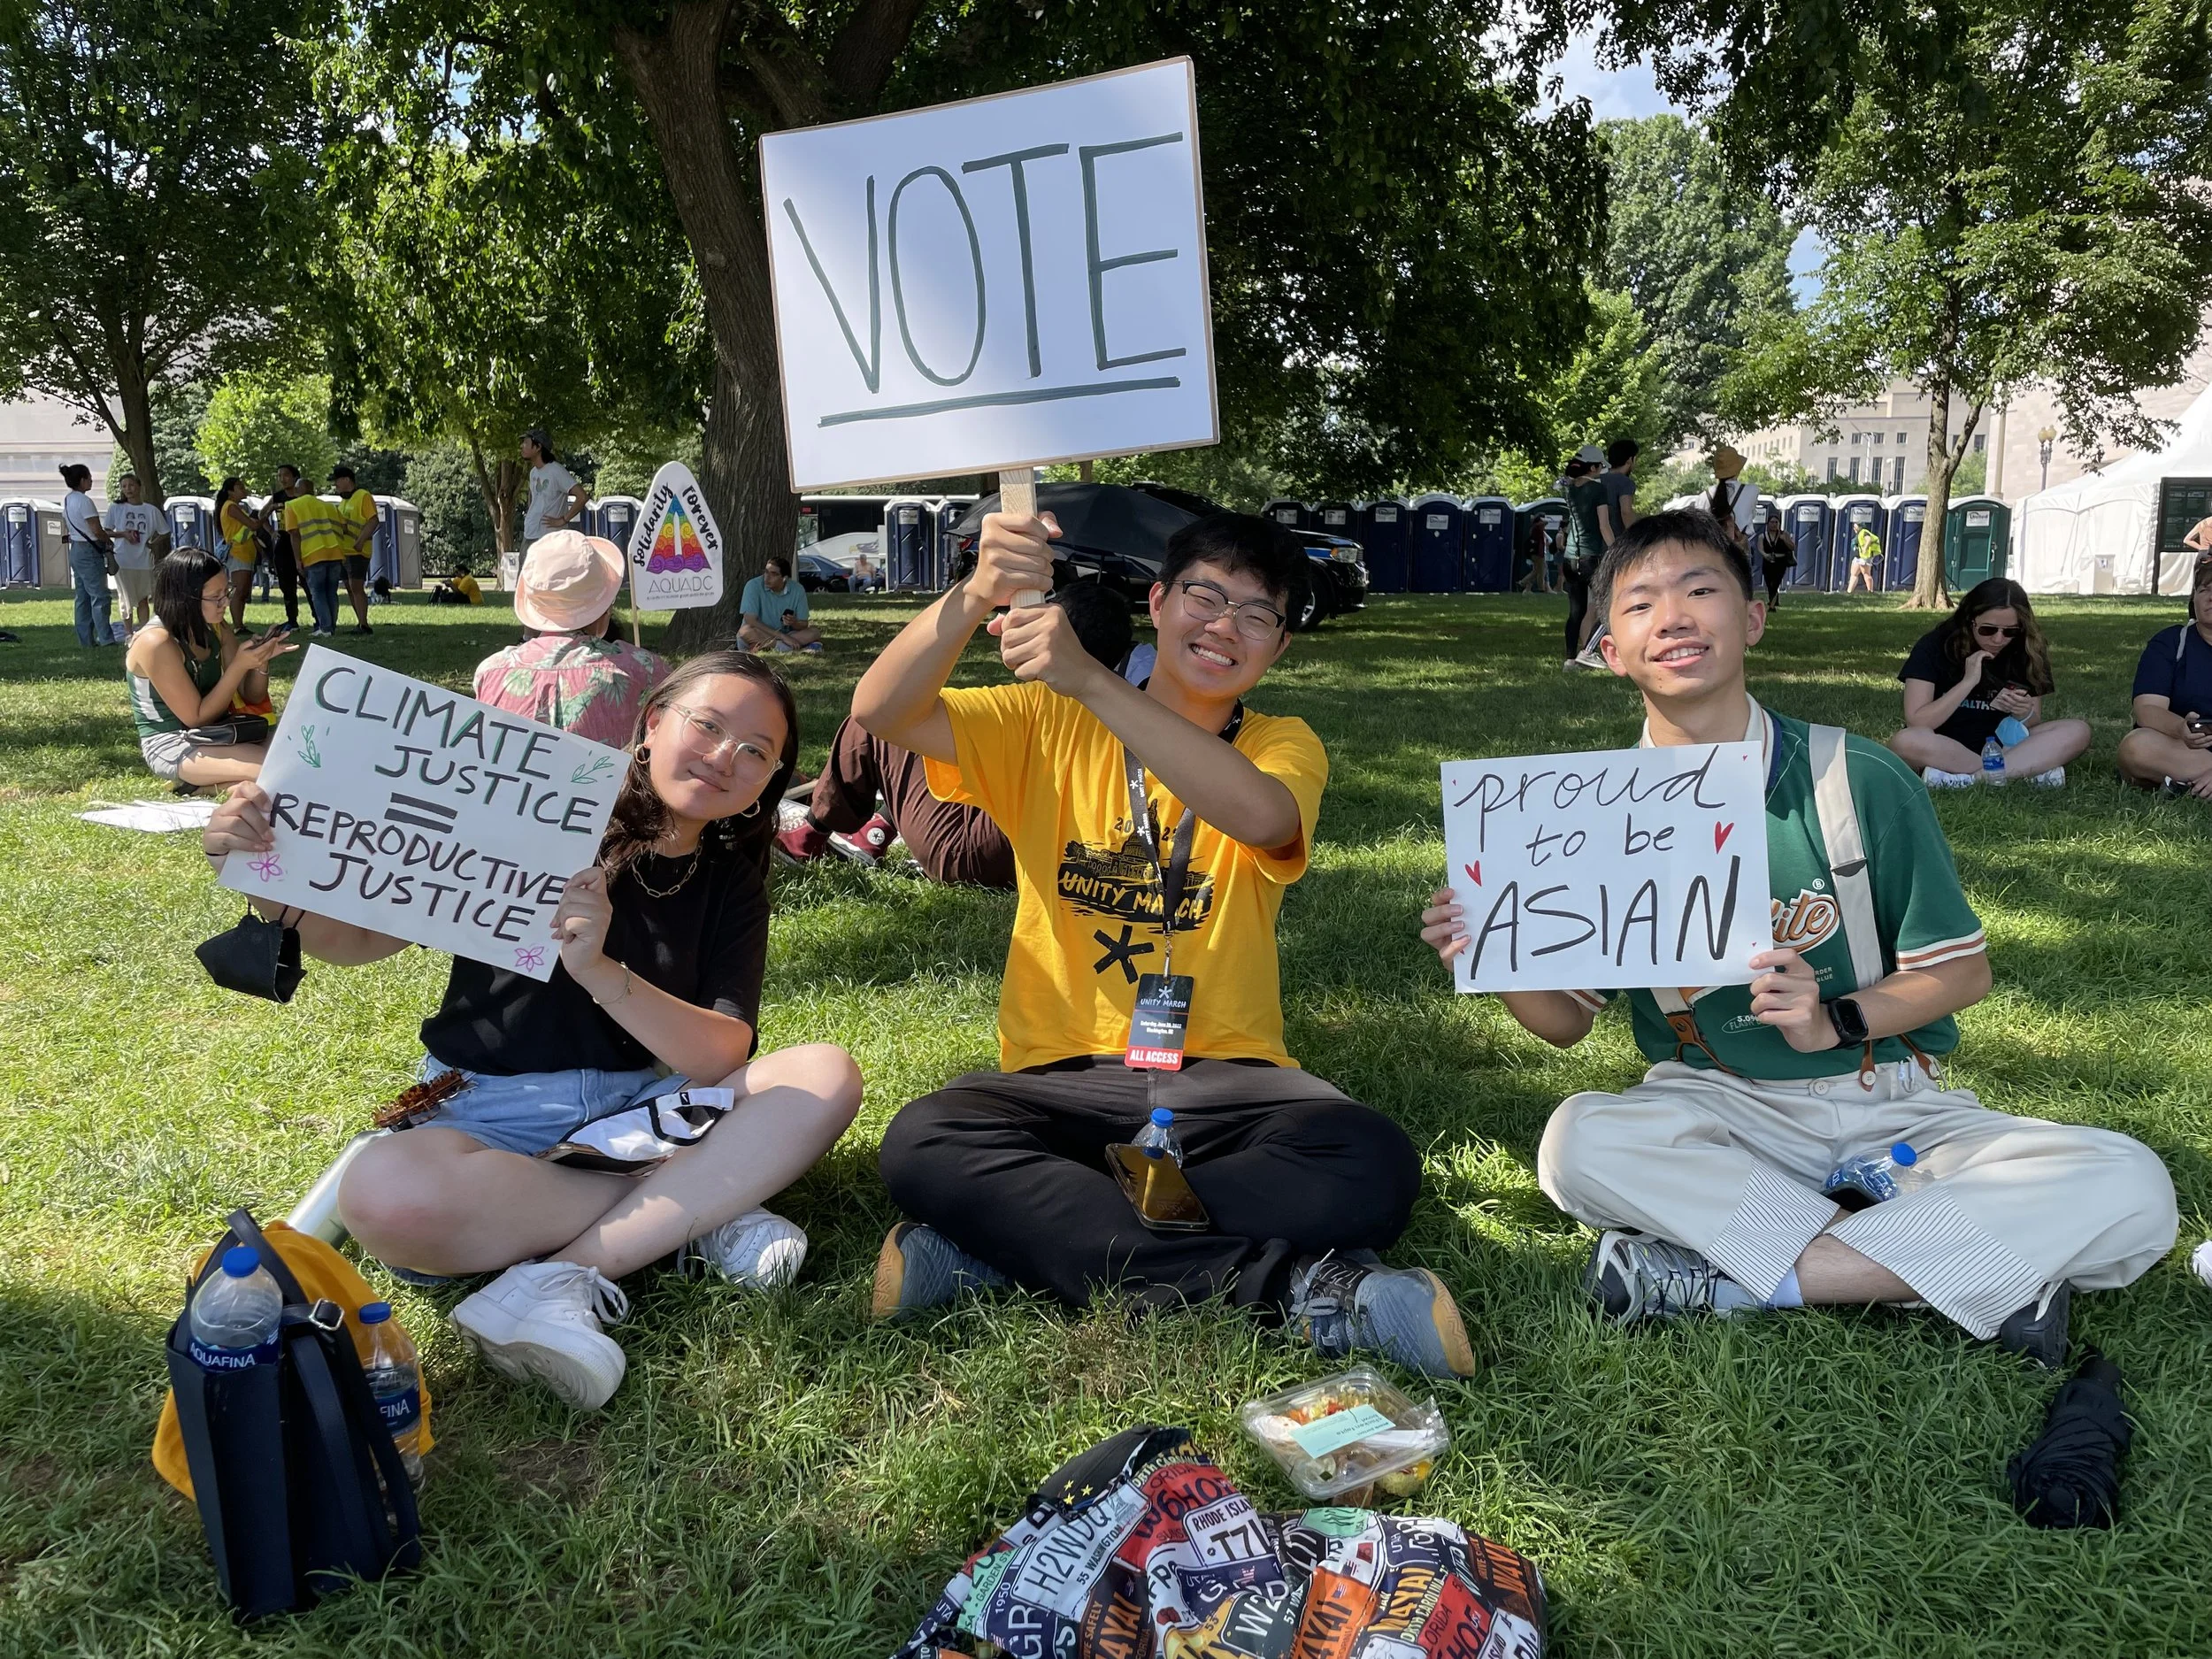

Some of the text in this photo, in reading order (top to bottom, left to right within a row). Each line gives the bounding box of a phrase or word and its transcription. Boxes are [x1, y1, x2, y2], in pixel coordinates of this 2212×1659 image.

[783, 131, 1187, 395] VOTE
[649, 575, 713, 593] AQUADC
[314, 666, 560, 780] CLIMATE
[374, 744, 600, 835] JUSTICE
[1454, 744, 1726, 852] proud
[269, 792, 570, 906] REPRODUCTIVE
[1525, 812, 1675, 866] to be
[309, 851, 536, 942] JUSTICE
[1062, 870, 1134, 906] UNITY
[1133, 891, 1204, 920] MACH
[1470, 855, 1741, 979] ASIAN
[1816, 974, 1833, 983] BLUE
[1163, 999, 1187, 1008] MARCH
[1129, 1049, 1179, 1064] ALL ACCESS
[189, 1341, 257, 1369] AQUAFINA
[1192, 1508, 1227, 1532] RHODE
[975, 1565, 1002, 1602] GARDEN
[1076, 1571, 1090, 1585] 55
[995, 1582, 1011, 1614] 1950
[1283, 1608, 1296, 1625] 57
[1084, 1600, 1103, 1640] SAFELY
